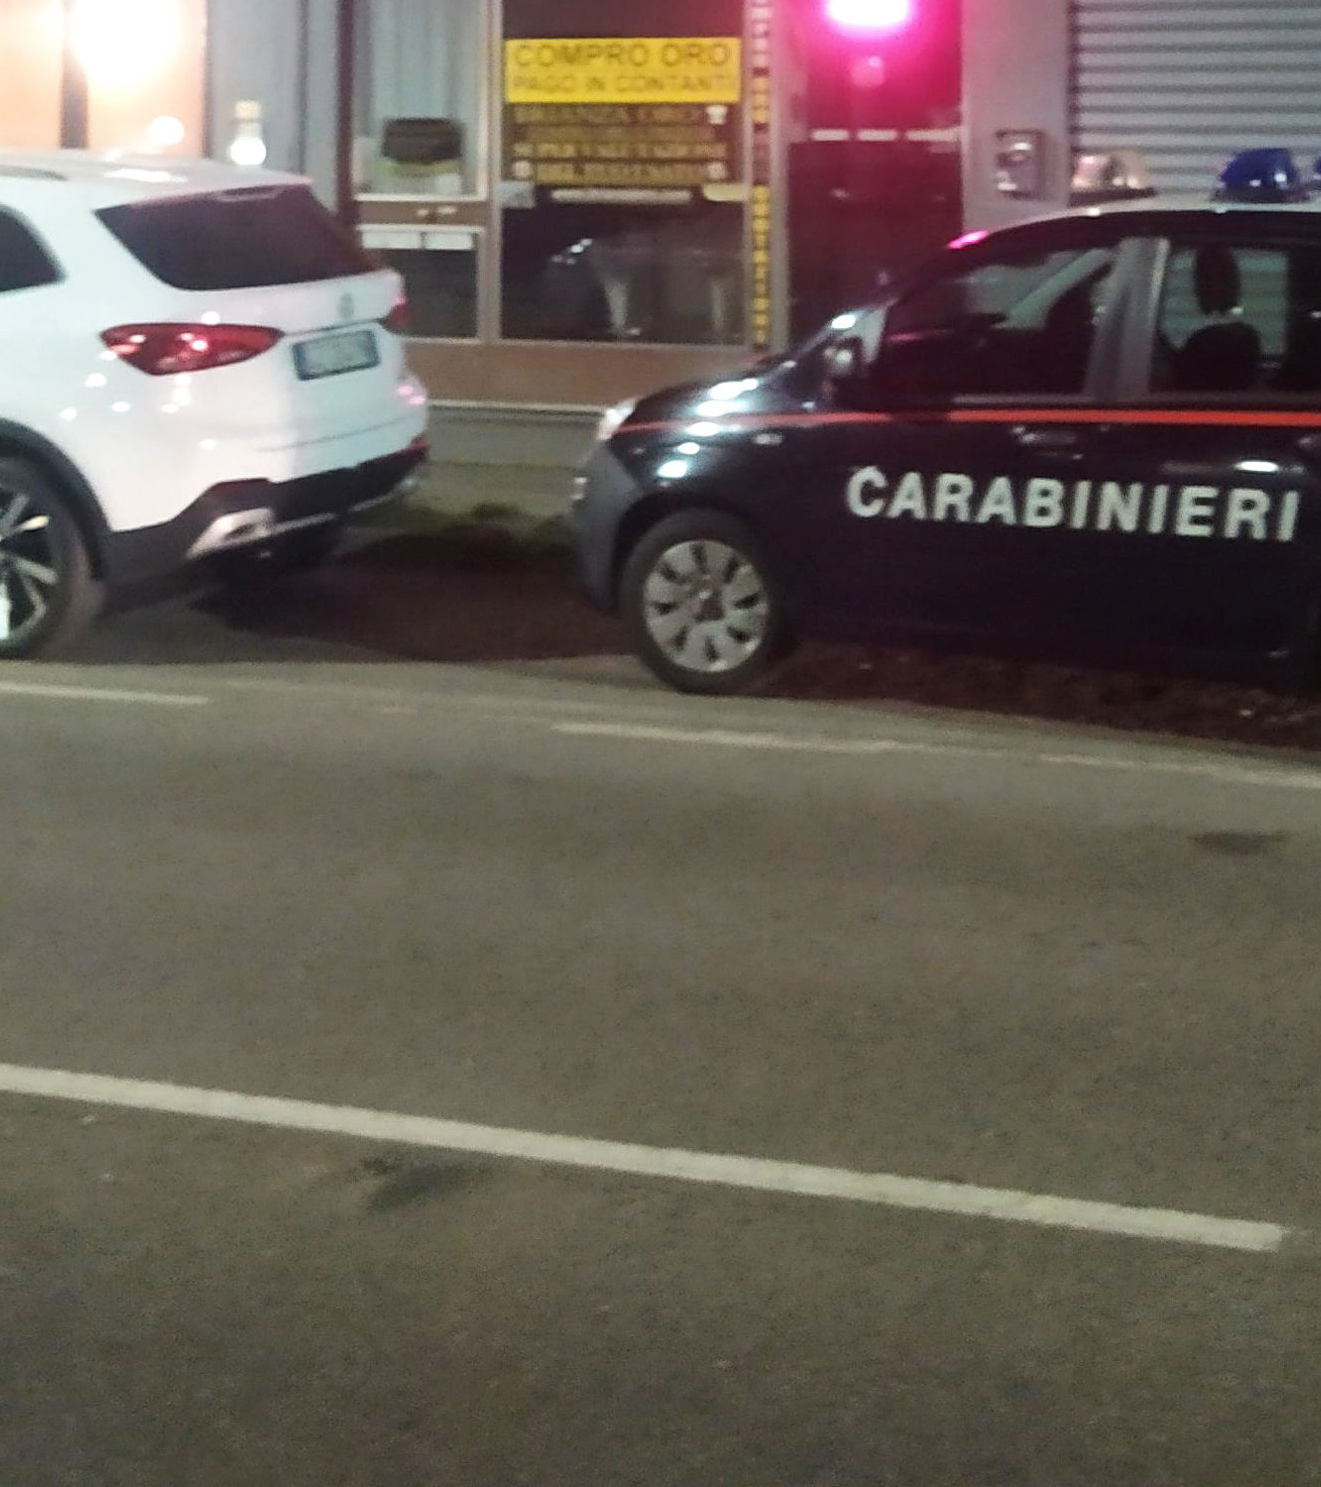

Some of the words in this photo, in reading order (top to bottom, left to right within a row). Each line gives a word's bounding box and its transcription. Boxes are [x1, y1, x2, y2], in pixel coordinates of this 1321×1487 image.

[514, 43, 650, 68] COMPRO
[661, 43, 728, 68] ORO
[514, 75, 577, 94] PAGO
[587, 75, 607, 92] IN
[615, 73, 734, 93] CONTANTI
[845, 466, 1301, 542] CARABINIERI
